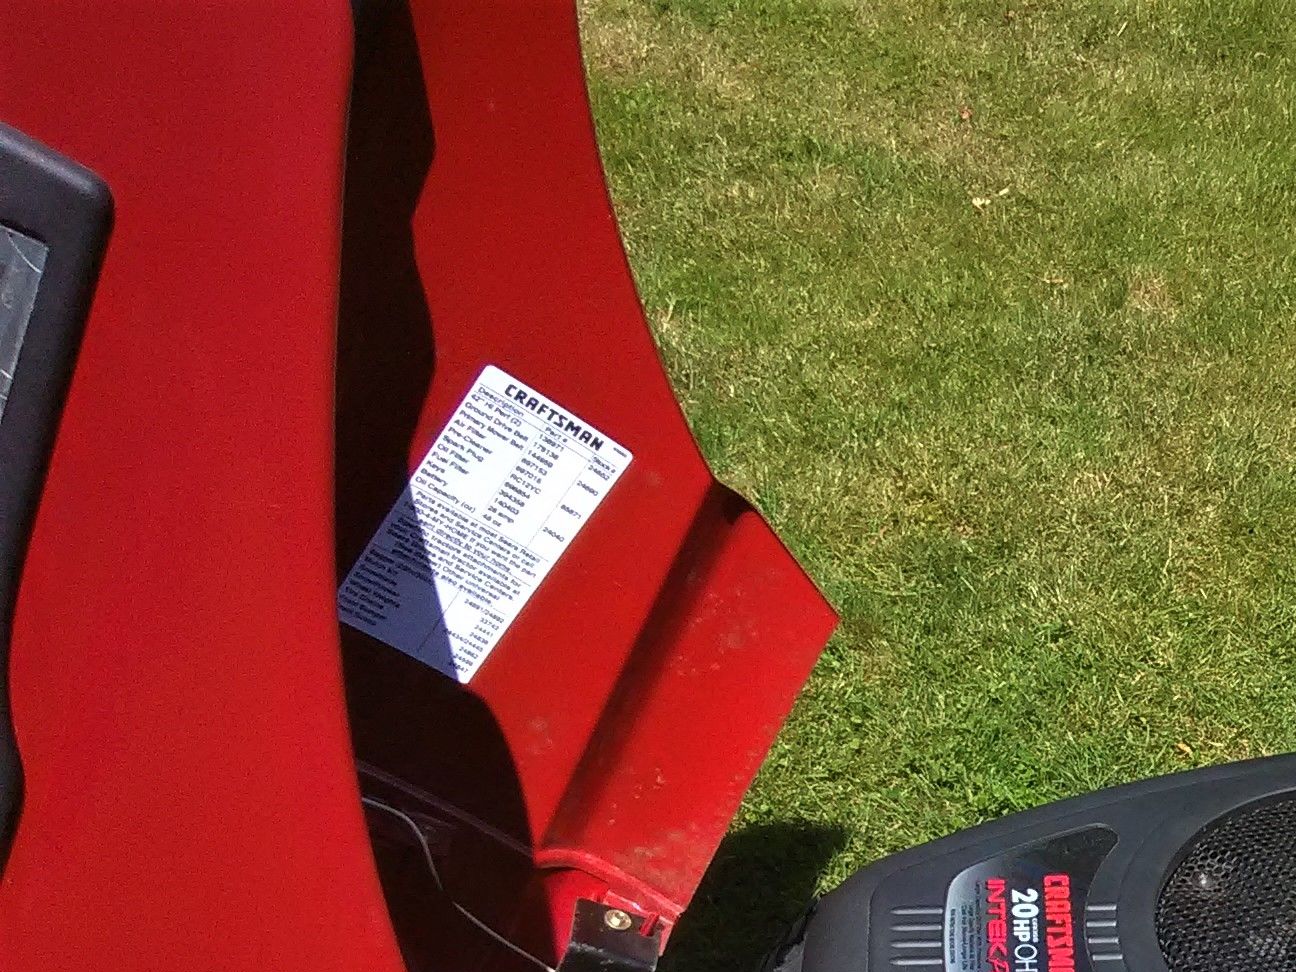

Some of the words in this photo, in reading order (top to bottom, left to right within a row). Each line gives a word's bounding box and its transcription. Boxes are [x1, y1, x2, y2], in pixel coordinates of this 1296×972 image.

[454, 418, 466, 428] Air
[466, 425, 486, 440] Filter
[458, 409, 486, 429] Primary
[486, 425, 509, 442] Mower
[509, 438, 524, 450] Belt
[464, 400, 493, 421] Ground
[492, 418, 513, 433] Drive
[513, 430, 529, 442] Belt
[476, 386, 525, 418] Description
[544, 426, 562, 439] Part
[503, 383, 605, 451] CRAFTSMAN
[436, 442, 449, 453] Oil
[449, 449, 470, 464] Filter
[441, 433, 466, 451] Spark
[465, 447, 485, 462] Plug
[448, 426, 493, 455] Pre-Cleaner
[425, 459, 446, 475] Keys
[431, 451, 449, 464] Fuel
[449, 460, 470, 475] Filter
[414, 475, 427, 485] Oil
[426, 482, 460, 504] Capacity
[419, 467, 448, 487] Battery
[496, 511, 515, 524] amp
[413, 497, 439, 515] Stores
[439, 512, 454, 523] and
[454, 520, 483, 539] Service
[482, 535, 512, 555] Centers
[415, 490, 436, 504] Parts
[436, 502, 469, 523] available
[478, 525, 497, 539] most
[497, 536, 519, 551] Sears
[519, 548, 541, 563] Retail
[430, 534, 462, 554] tractors
[462, 552, 509, 580] attachments
[510, 578, 522, 587] for
[437, 555, 453, 566] and
[454, 564, 483, 583] Service
[450, 554, 477, 571] tractor
[477, 569, 511, 590] available
[474, 541, 489, 552] you
[489, 549, 508, 562] want
[508, 559, 521, 569] the
[520, 566, 537, 578] part
[440, 574, 458, 586] also
[441, 565, 464, 580] Other
[464, 578, 500, 600] universal
[986, 878, 1008, 960] INTEK
[1012, 888, 1039, 919] 20
[1013, 920, 1031, 942] HP
